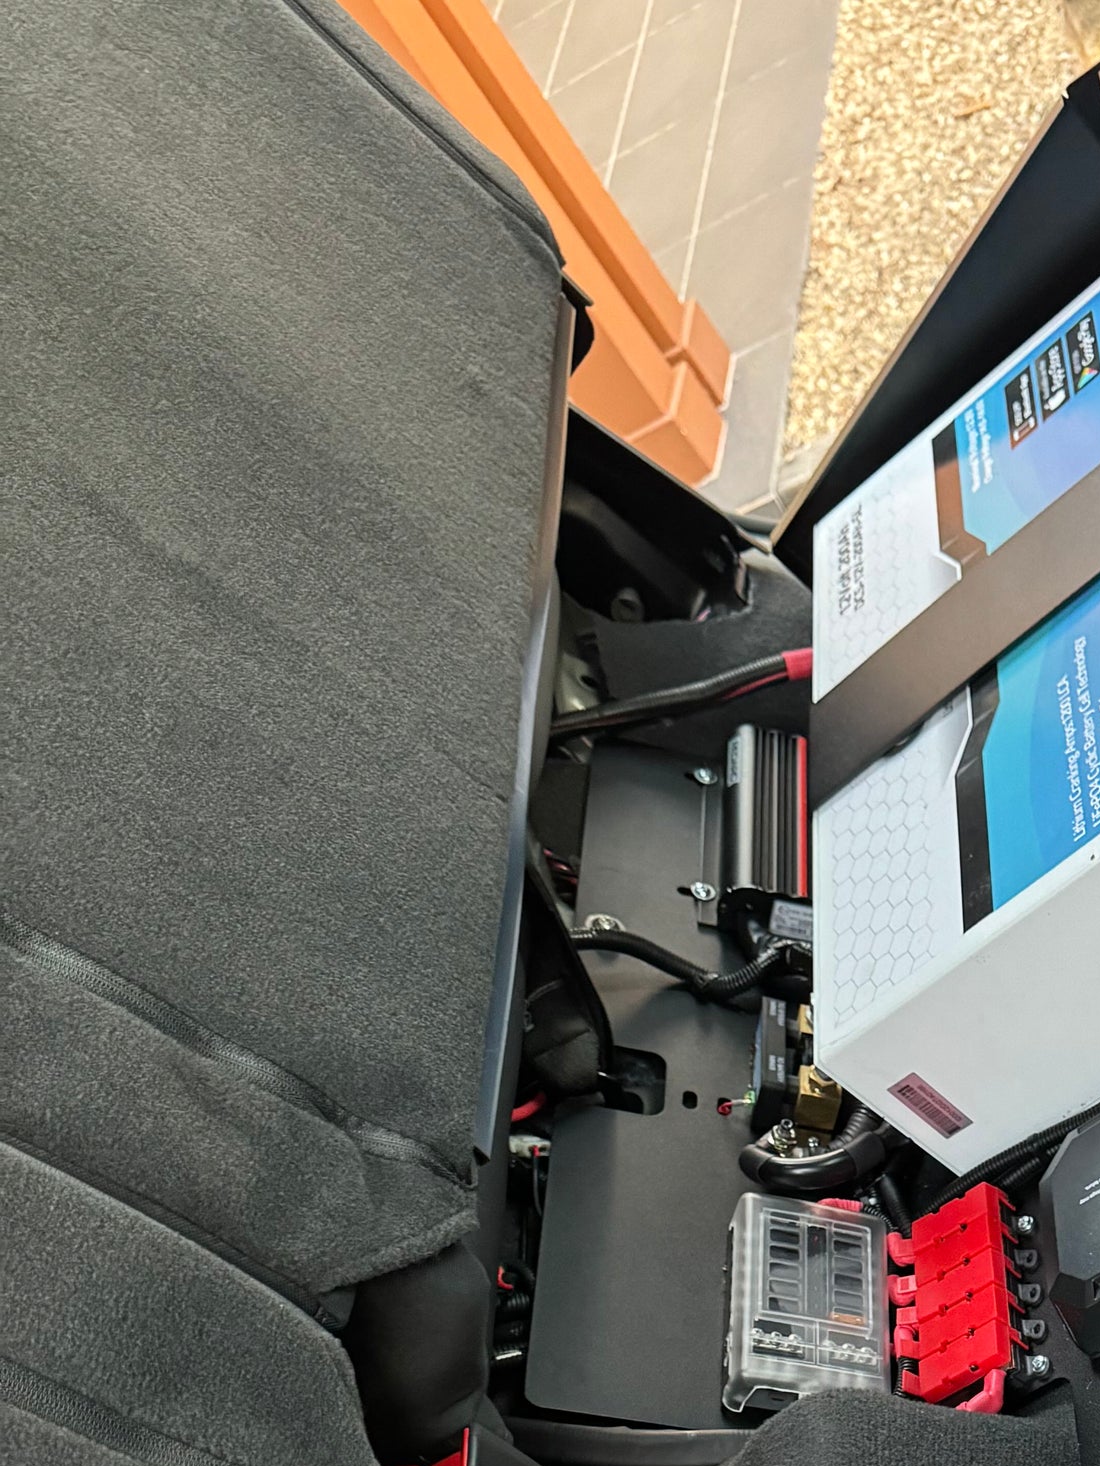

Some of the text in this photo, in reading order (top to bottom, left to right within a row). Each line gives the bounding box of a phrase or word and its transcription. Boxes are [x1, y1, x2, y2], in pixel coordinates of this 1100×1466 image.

[1074, 637, 1088, 692] Technology
[1078, 690, 1091, 712] Cell
[1083, 709, 1095, 749] Battery
[1067, 751, 1081, 801] Cranking
[1072, 798, 1085, 841] Lithium
